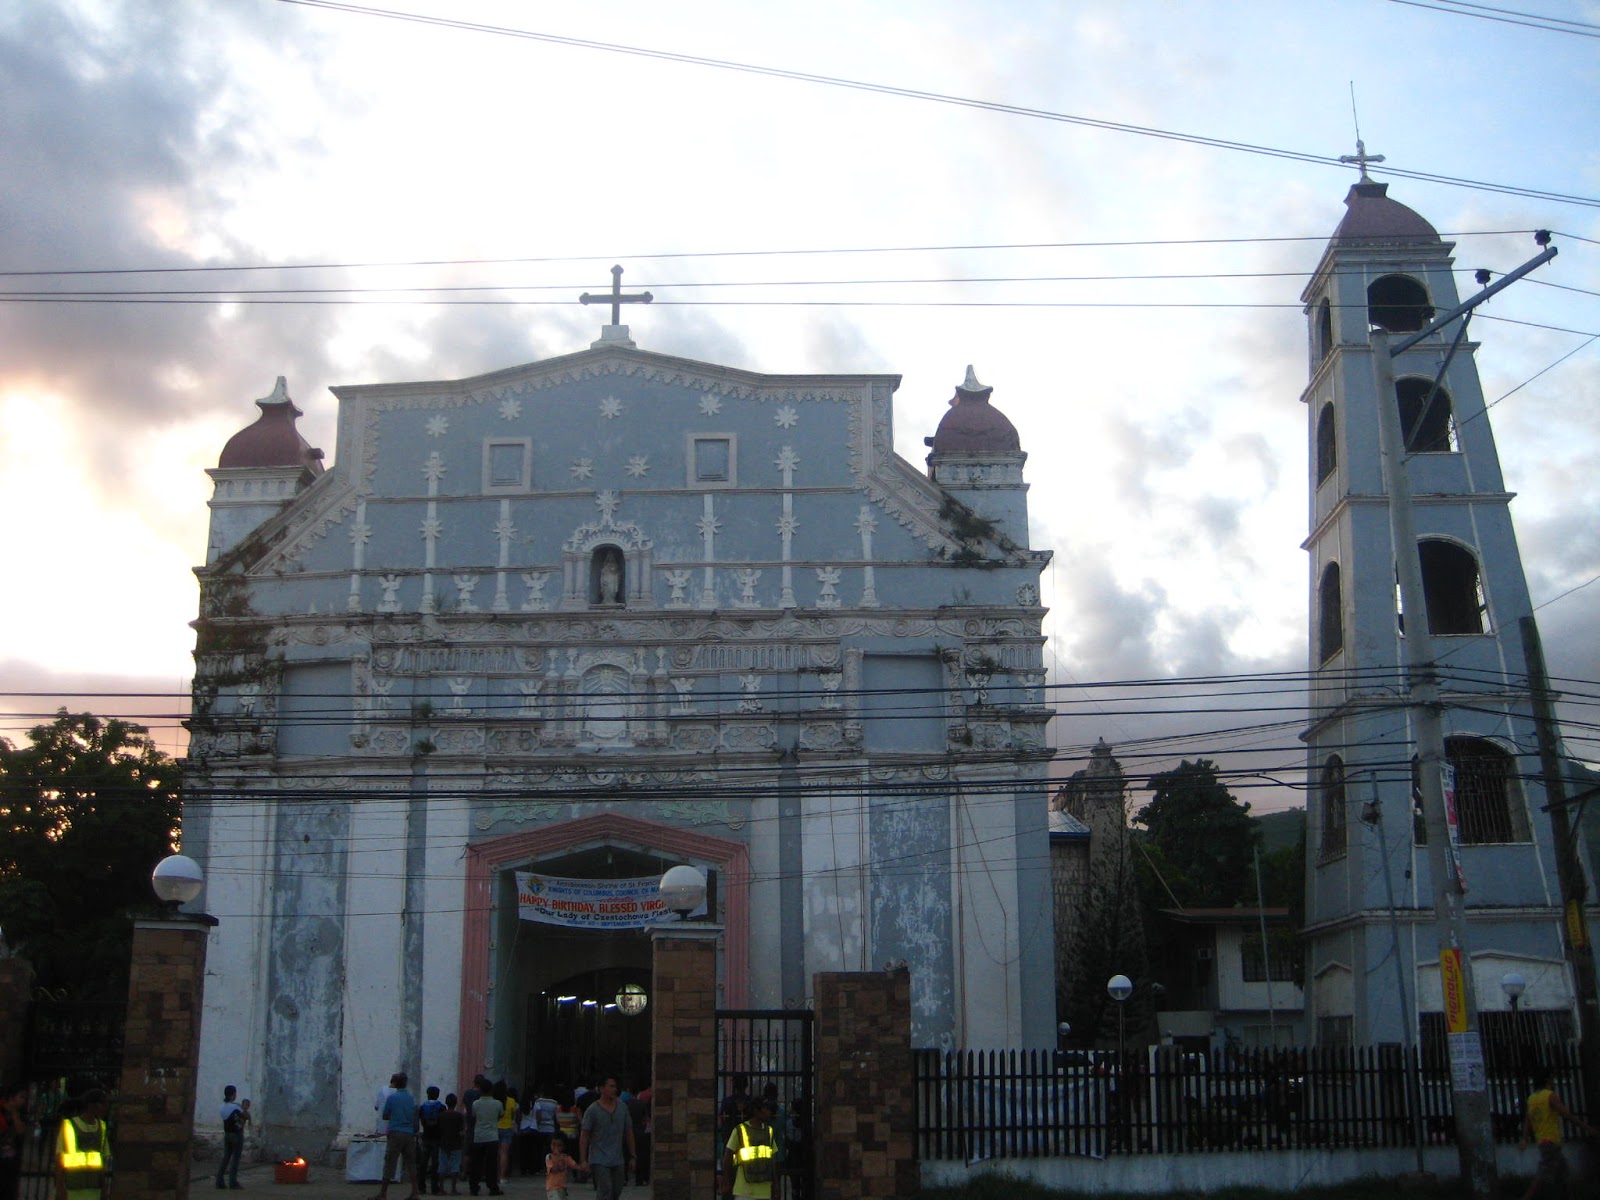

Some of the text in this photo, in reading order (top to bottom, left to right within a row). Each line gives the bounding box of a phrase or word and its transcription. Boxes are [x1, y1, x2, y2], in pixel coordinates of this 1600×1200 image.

[520, 893, 549, 908] HAPPY
[599, 902, 638, 914] BLESSED
[641, 899, 667, 912] VIRGI
[557, 911, 578, 921] Lady
[593, 912, 649, 921] Czestochowa
